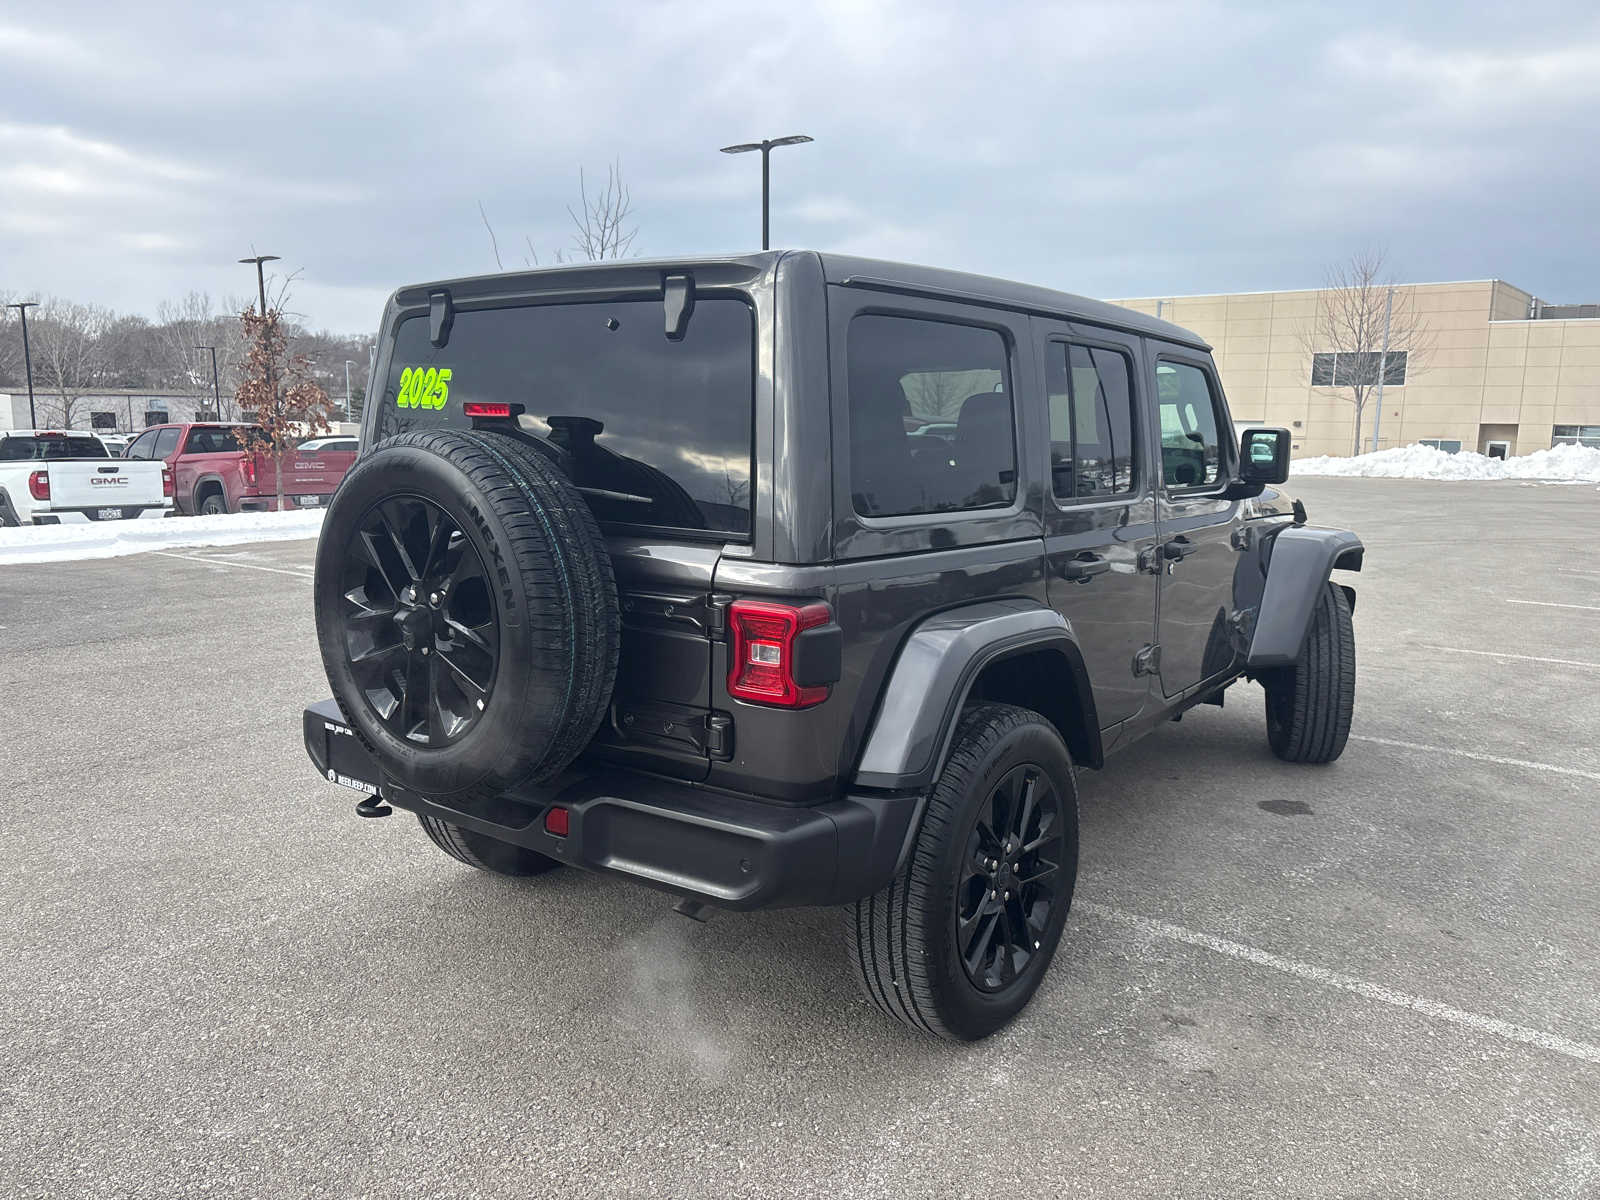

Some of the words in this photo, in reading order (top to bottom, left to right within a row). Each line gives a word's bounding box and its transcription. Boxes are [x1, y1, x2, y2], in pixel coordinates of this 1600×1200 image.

[397, 367, 453, 410] 2025
[90, 477, 128, 485] GMC
[469, 505, 516, 610] NEXEN
[338, 775, 376, 795] REEDJEEP.COM
